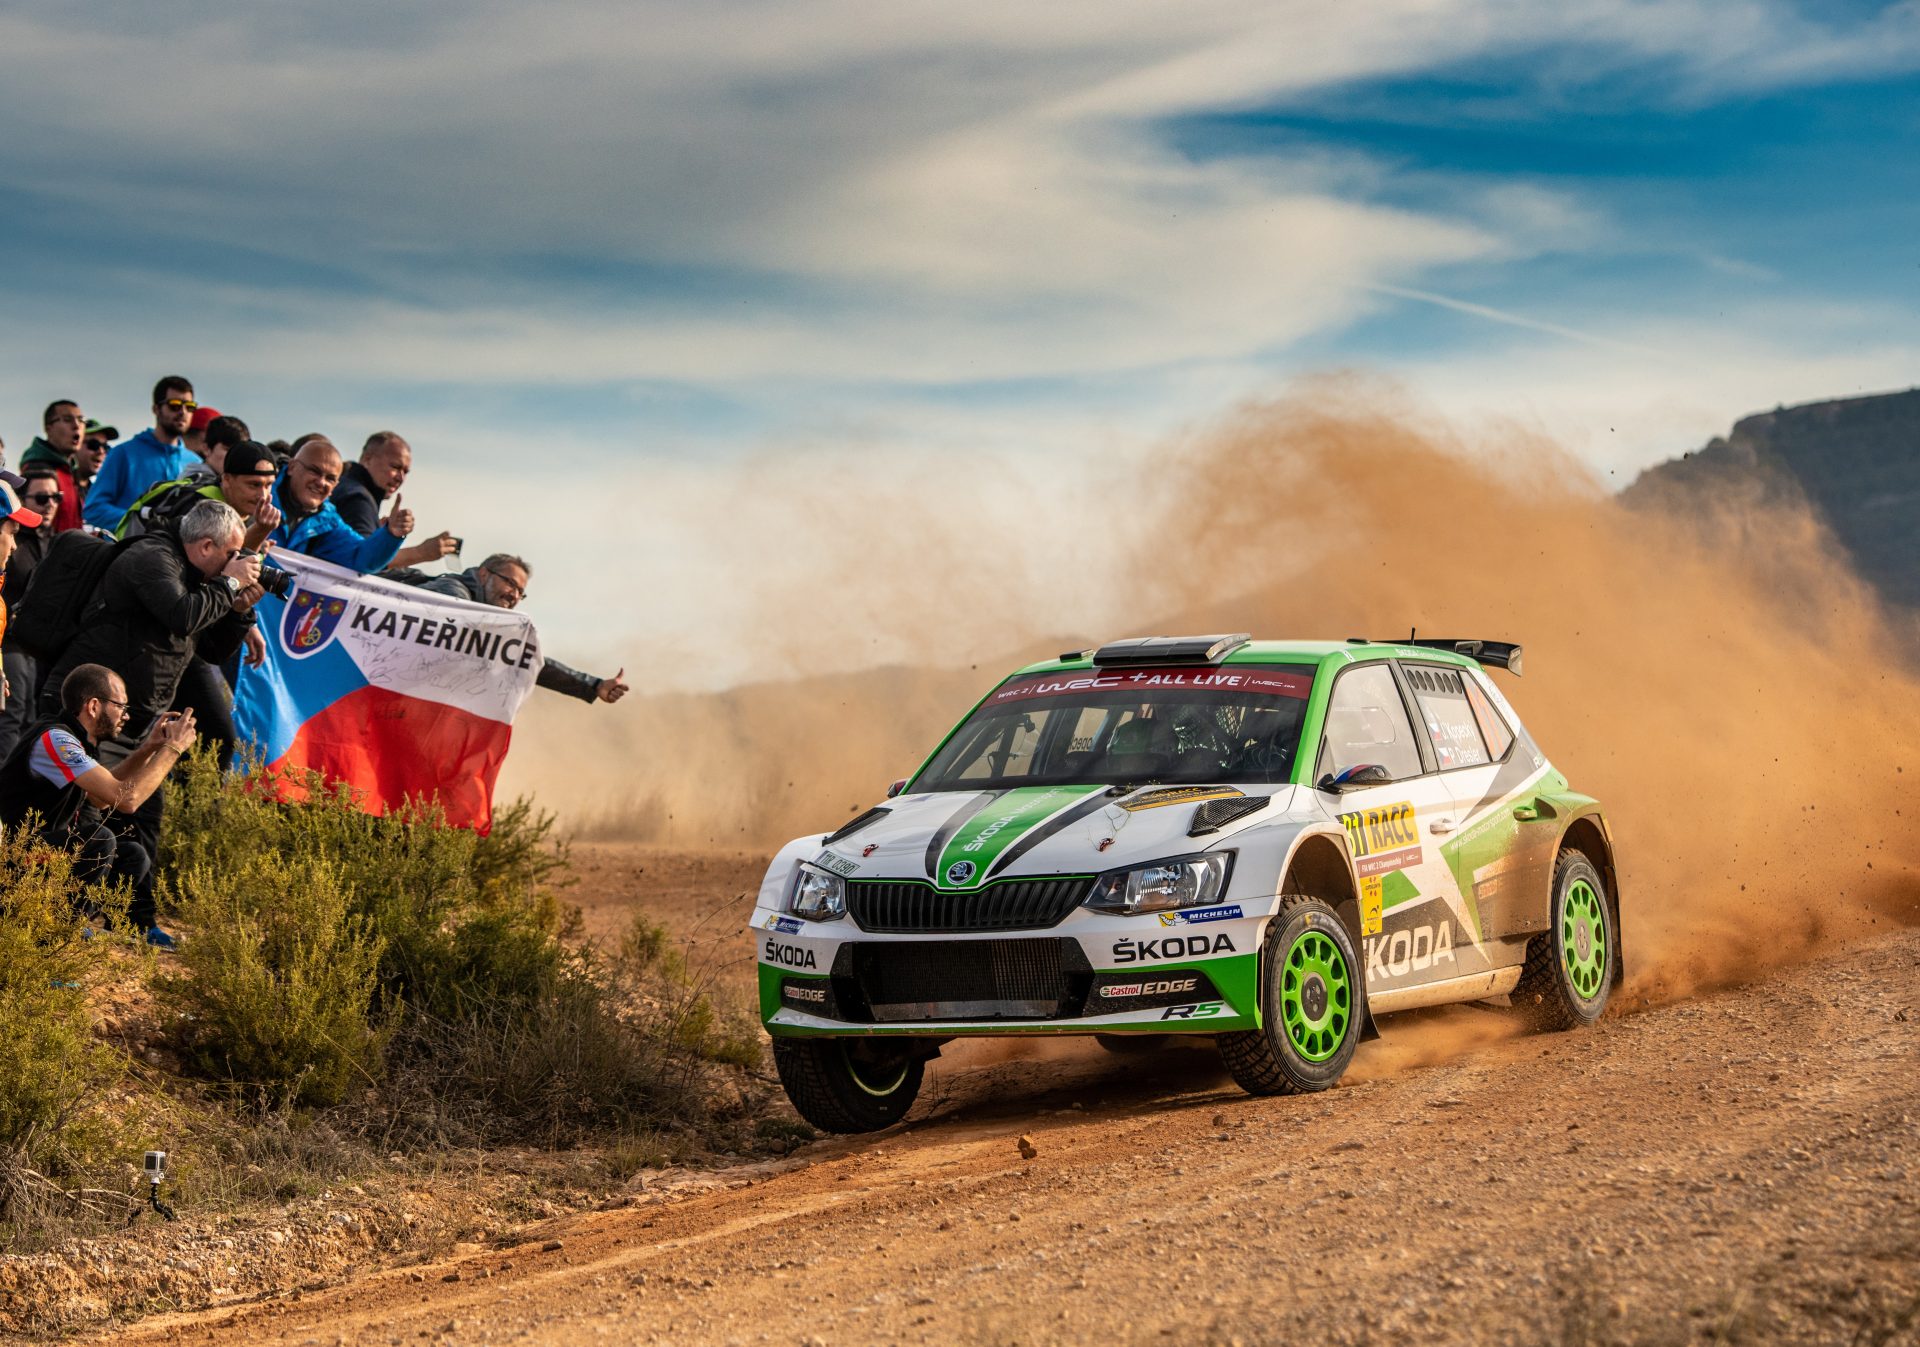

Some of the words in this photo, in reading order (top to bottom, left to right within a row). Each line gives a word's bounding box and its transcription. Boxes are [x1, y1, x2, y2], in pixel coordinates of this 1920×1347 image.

[351, 605, 536, 670] KATEŘINICE
[1036, 677, 1123, 693] WRC
[1192, 674, 1243, 686] LIVE
[997, 689, 1018, 699] WRC
[962, 815, 1018, 852] ŠKODA
[1368, 804, 1414, 849] RACC
[831, 859, 856, 875] 0390
[1189, 908, 1241, 920] MICHELIN
[765, 937, 817, 969] ŠKODA
[1112, 933, 1237, 963] ŠKODA
[1362, 921, 1456, 982] KODA
[799, 988, 826, 1002] EDGE
[1110, 985, 1140, 996] Castrol
[1142, 978, 1199, 995] EDGE
[1160, 1002, 1225, 1020] R5
